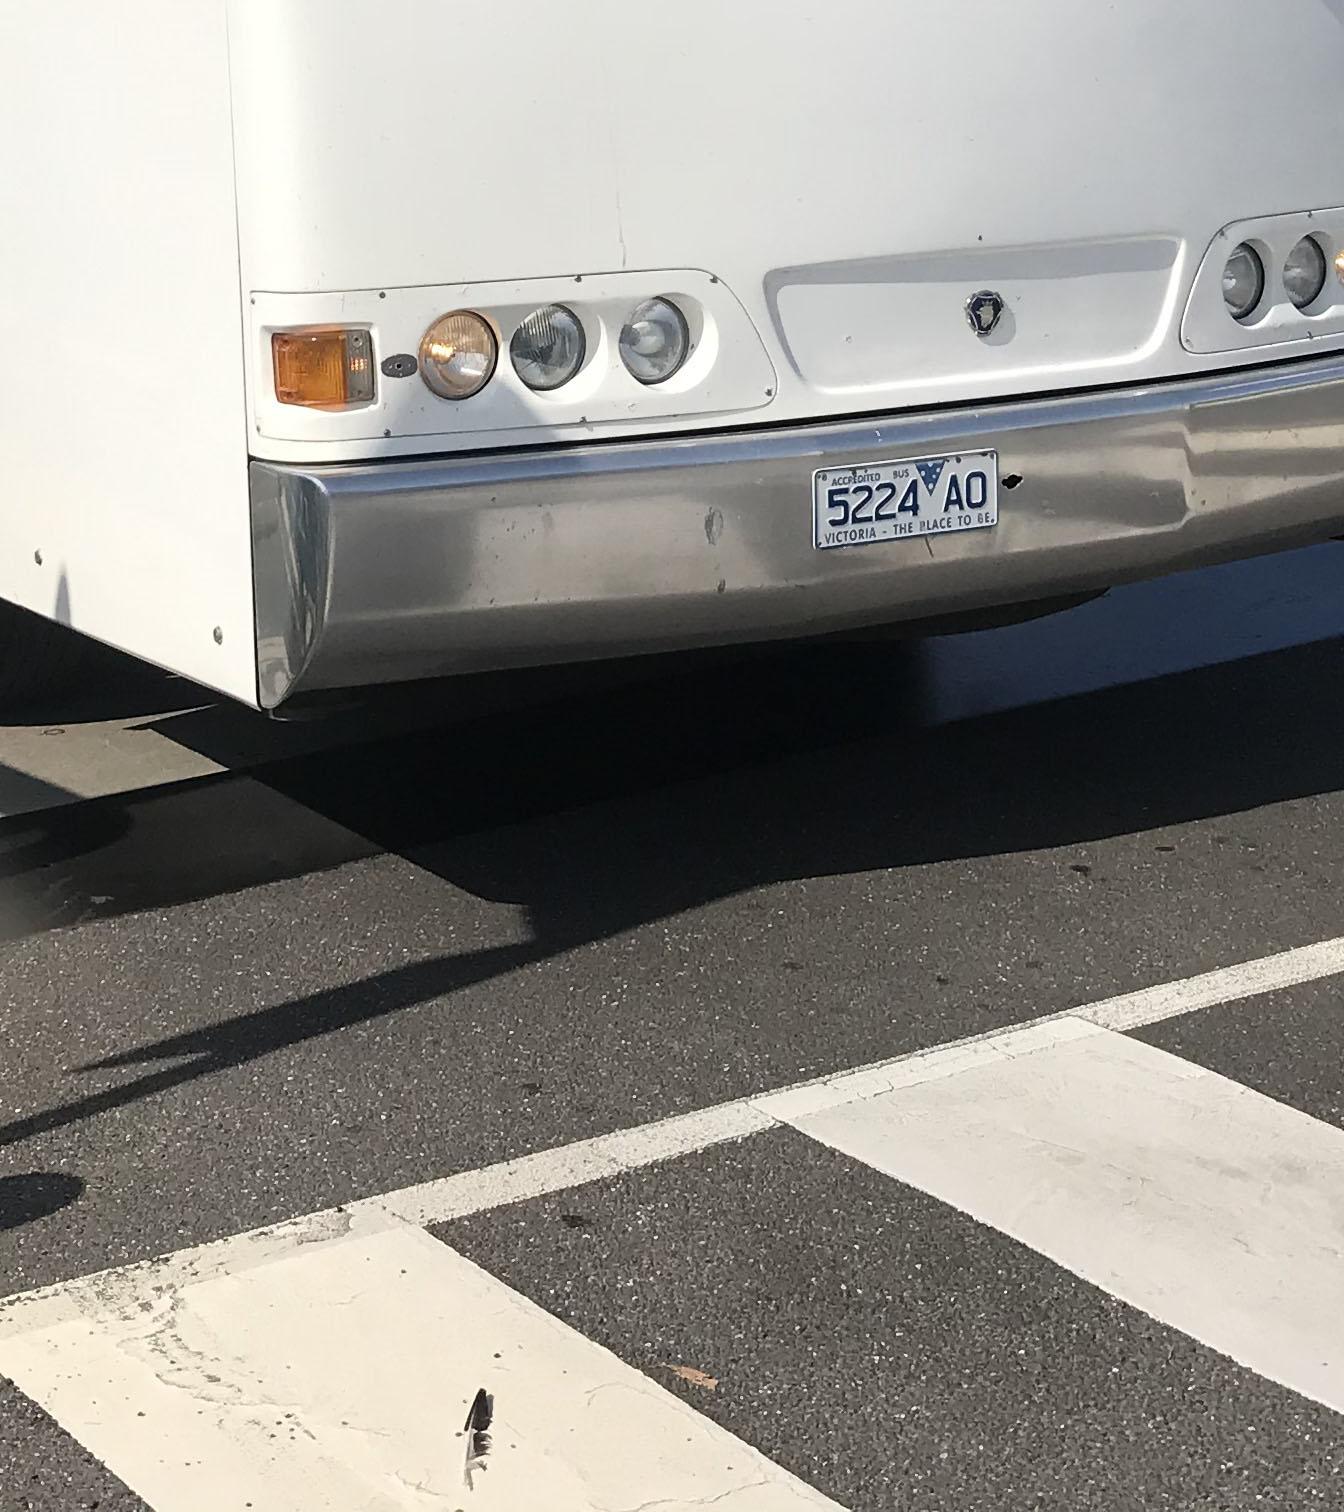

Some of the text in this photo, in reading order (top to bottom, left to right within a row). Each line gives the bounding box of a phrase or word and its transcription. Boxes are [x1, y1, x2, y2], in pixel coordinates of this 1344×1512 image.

[831, 468, 910, 486] ACCREDITED BUS
[828, 479, 920, 527] 5224
[824, 527, 877, 545] VICTORIA
[893, 521, 914, 535] THE
[920, 516, 952, 532] PLACE
[957, 514, 972, 527] TO
